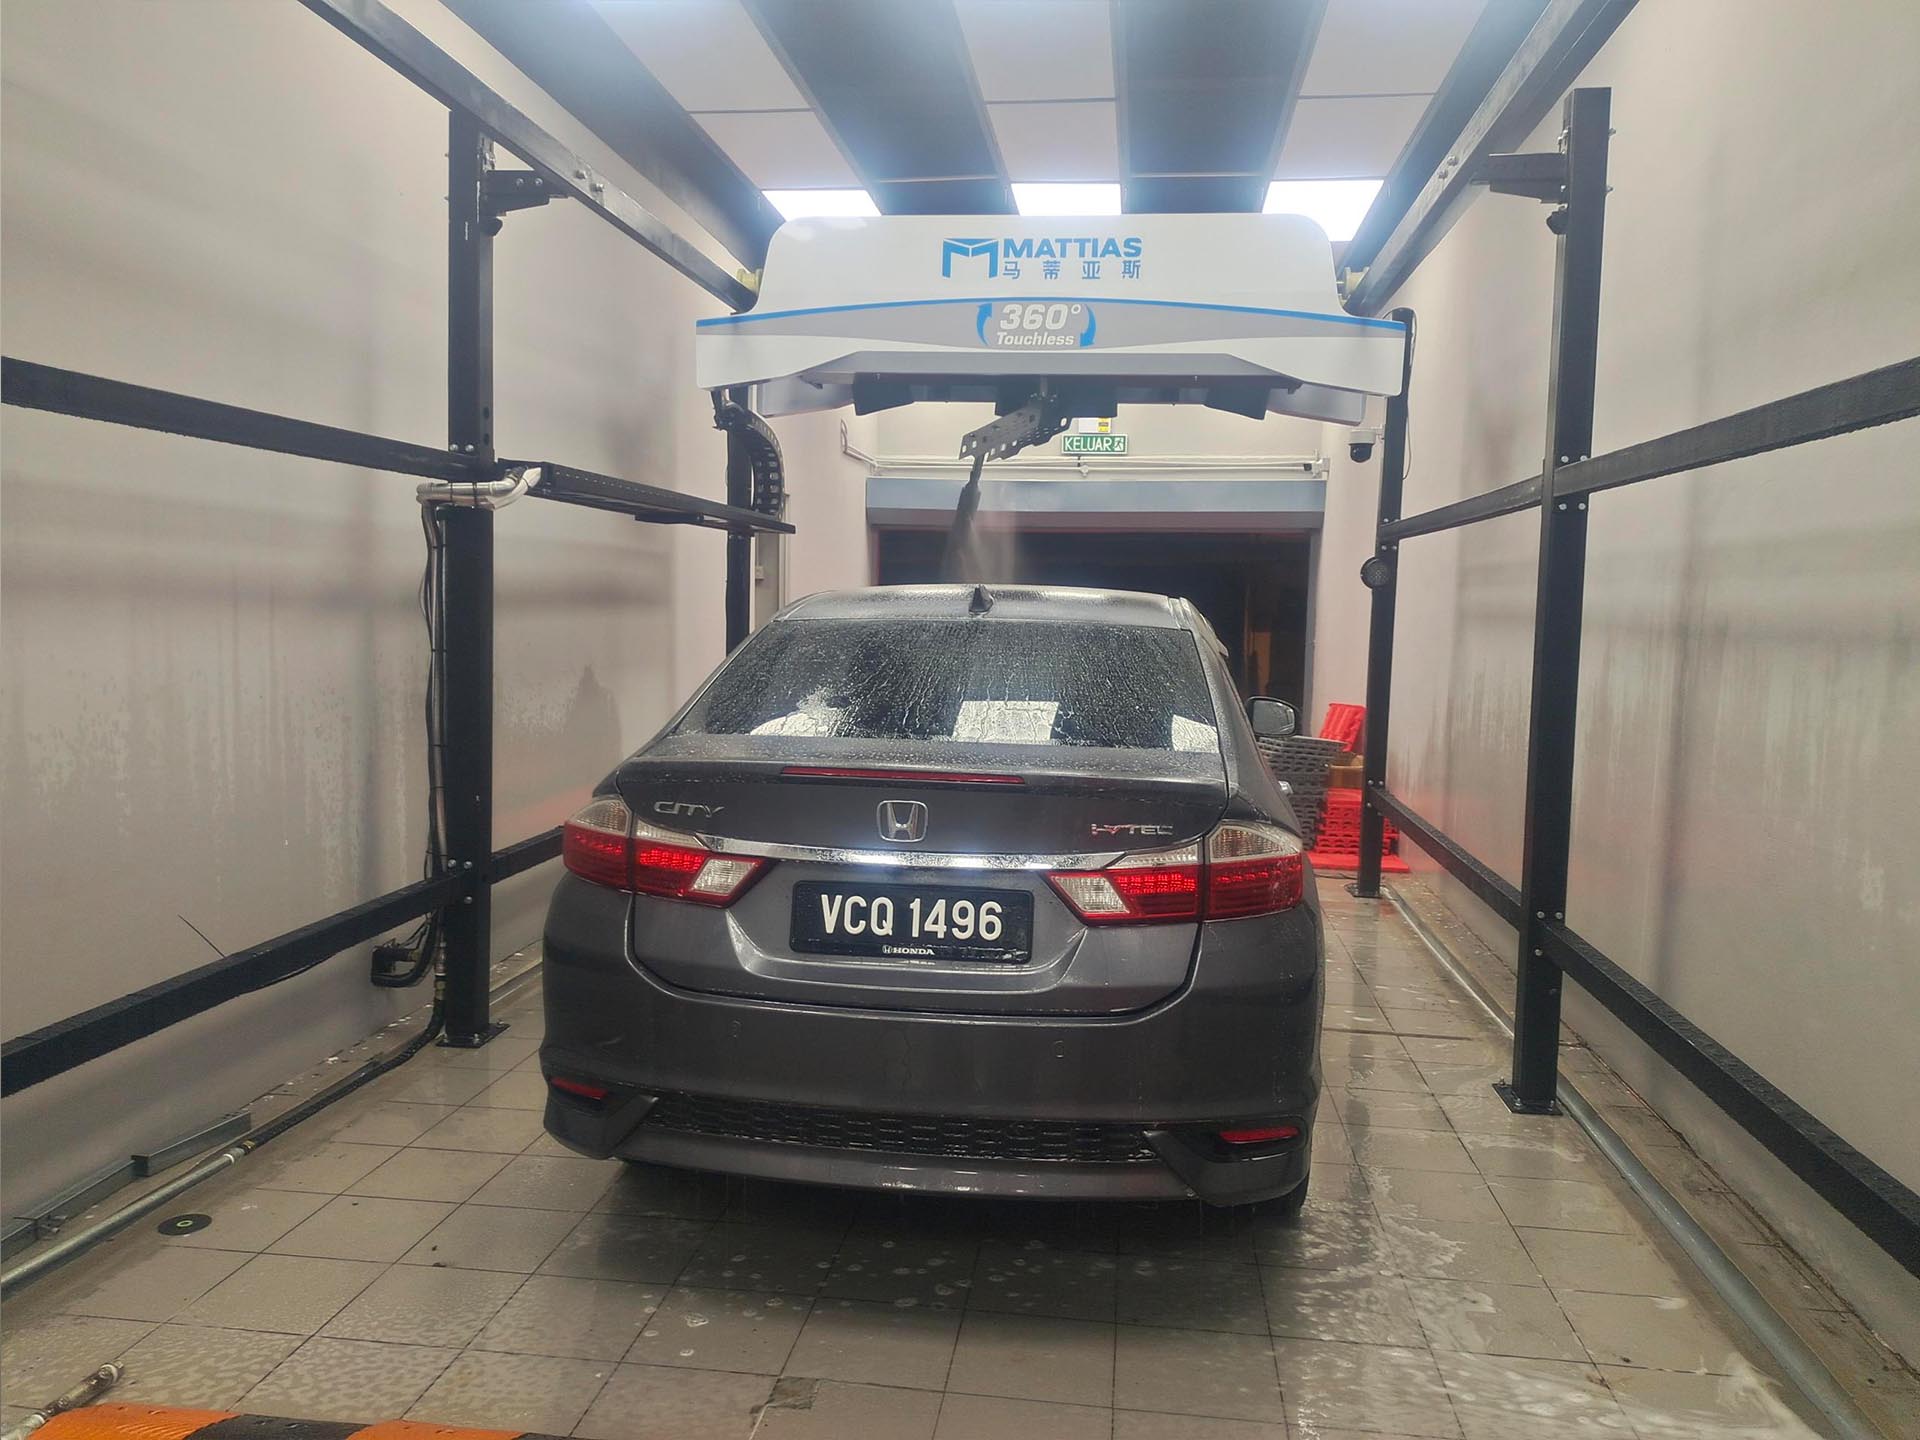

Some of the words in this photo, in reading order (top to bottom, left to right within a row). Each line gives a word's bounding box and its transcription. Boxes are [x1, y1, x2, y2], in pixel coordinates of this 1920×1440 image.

[1003, 237, 1142, 258] MATTIAS
[1002, 260, 1141, 279] 马蒂亚斯
[997, 332, 1074, 346] Touchless
[1064, 436, 1112, 451] KELUAR
[653, 801, 725, 818] CITY
[820, 894, 894, 936] VCQ
[909, 898, 1003, 941] 1496
[893, 946, 936, 956] HONDA
